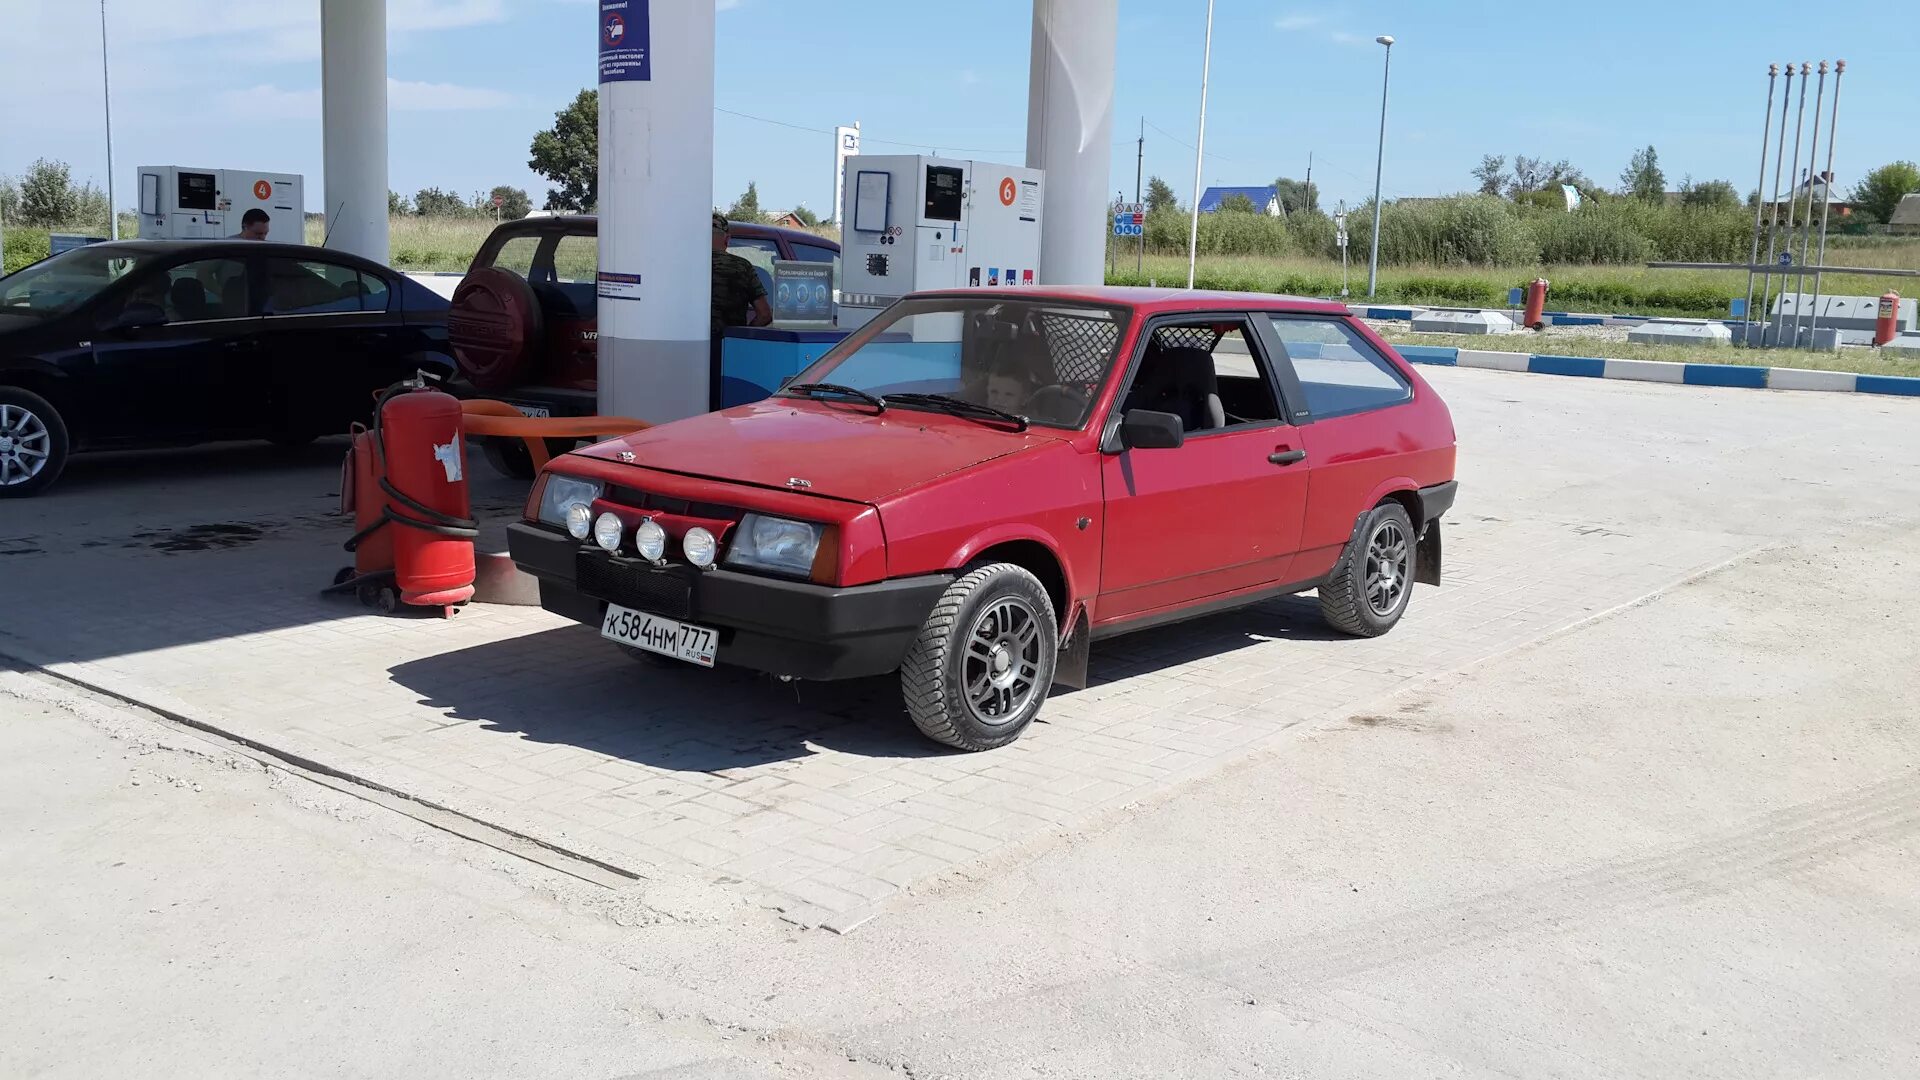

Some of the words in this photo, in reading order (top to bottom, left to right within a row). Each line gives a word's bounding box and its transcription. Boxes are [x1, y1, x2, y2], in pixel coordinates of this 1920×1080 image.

[258, 184, 267, 197] 4
[1004, 182, 1012, 200] 6
[680, 625, 711, 652] 777
[686, 649, 701, 660] RUS
